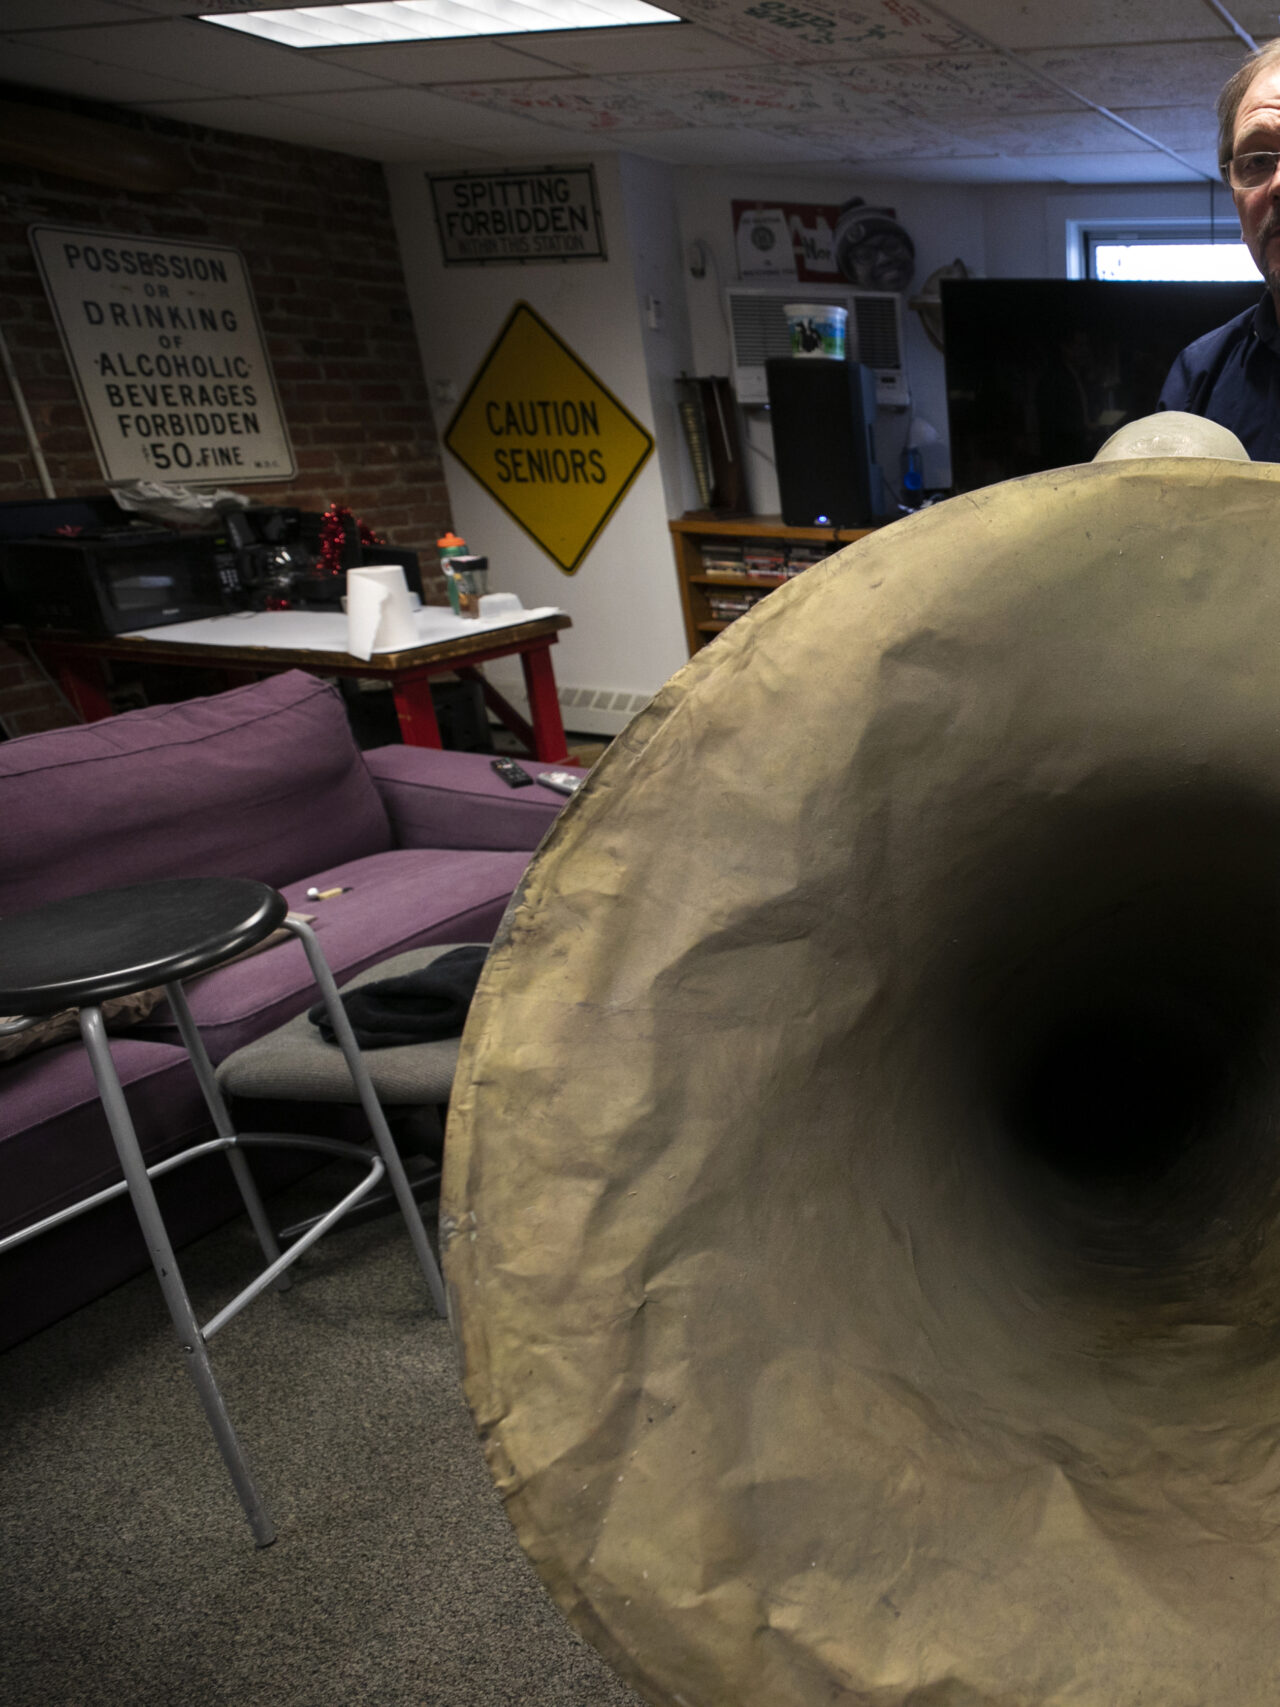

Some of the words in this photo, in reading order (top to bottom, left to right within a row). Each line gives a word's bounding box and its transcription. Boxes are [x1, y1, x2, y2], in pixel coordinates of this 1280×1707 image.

[453, 178, 570, 208] SPITTING
[445, 205, 589, 237] FORBIDDEN
[502, 237, 529, 253] THIS
[535, 234, 585, 250] STATION
[62, 243, 229, 283] POSSESSION
[143, 282, 171, 299] OR
[83, 300, 238, 333] DRINKING
[158, 335, 183, 350] OF
[99, 352, 251, 379] ALCOHOLIC
[105, 384, 257, 408] BEVERAGES
[118, 414, 260, 437] FORBIDDEN
[485, 400, 601, 436] CAUTION
[493, 448, 606, 483] SENIORS
